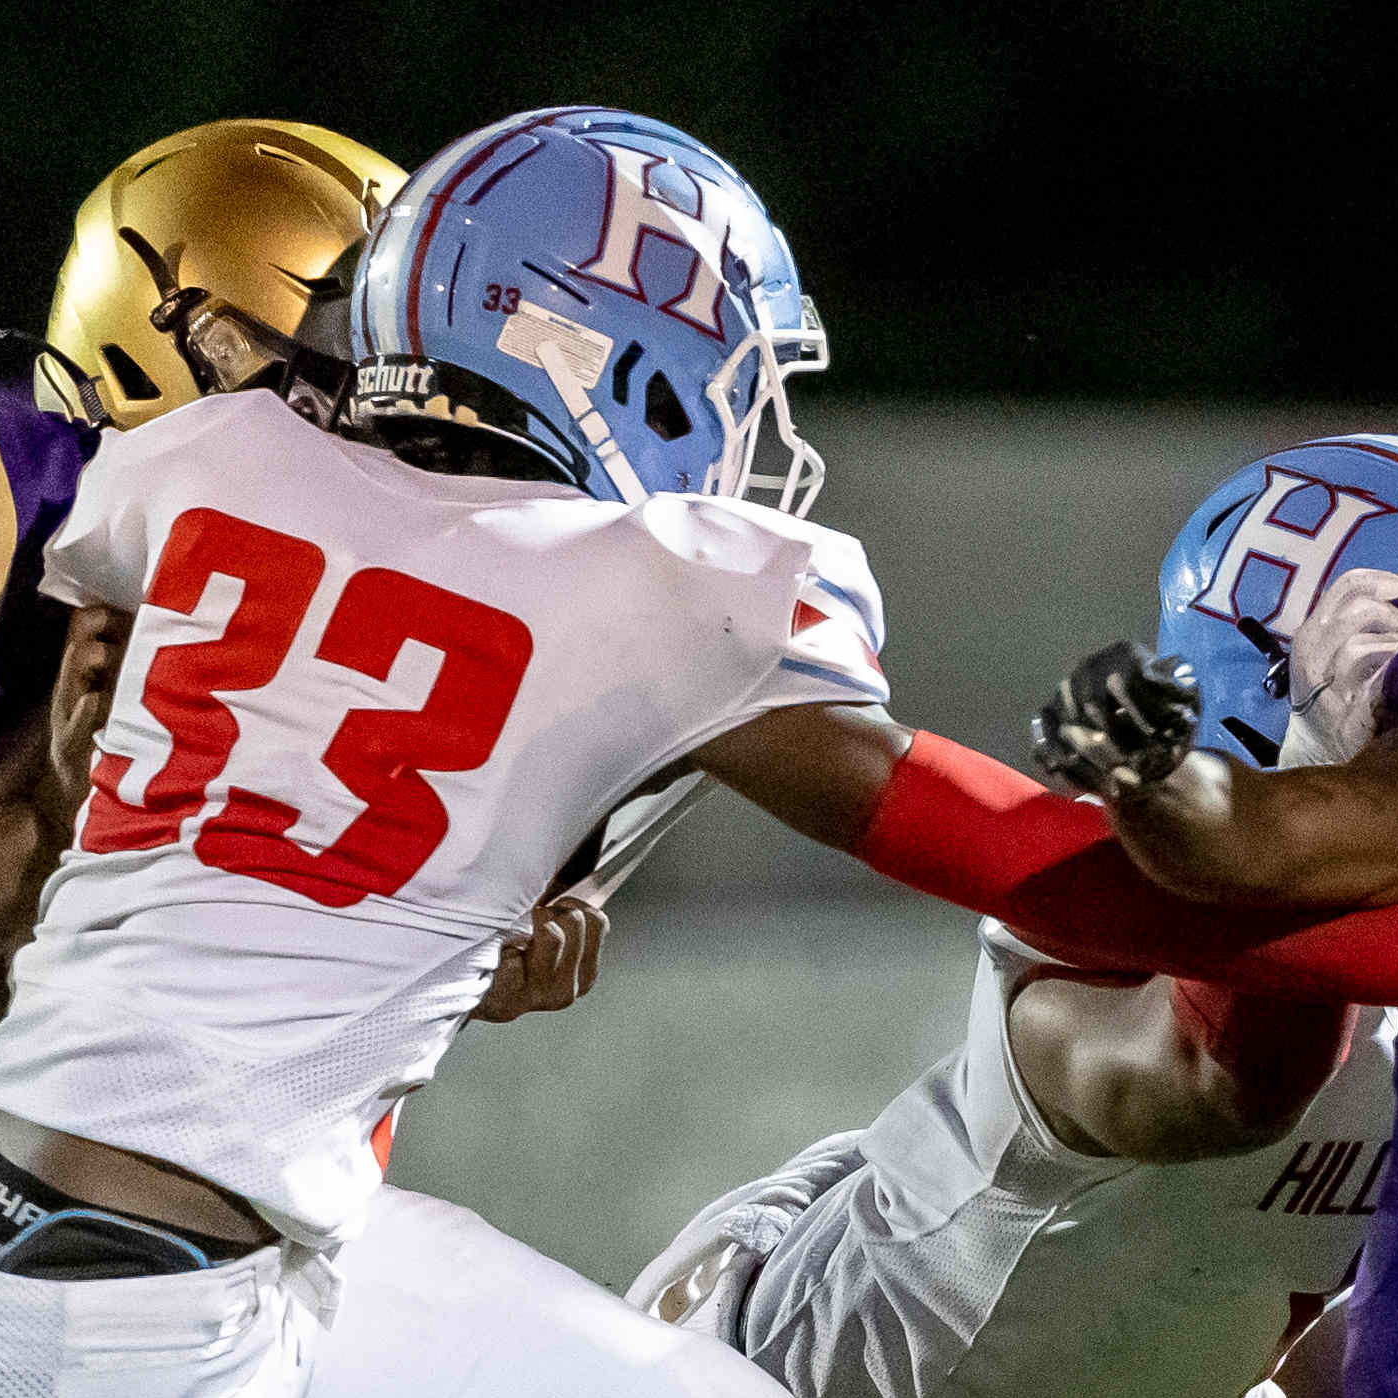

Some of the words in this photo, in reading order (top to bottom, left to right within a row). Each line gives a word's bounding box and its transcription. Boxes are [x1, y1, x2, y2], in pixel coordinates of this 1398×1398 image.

[482, 283, 522, 316] 33
[566, 136, 740, 343] H
[80, 507, 534, 908] 33
[1256, 1141, 1393, 1216] HILL
